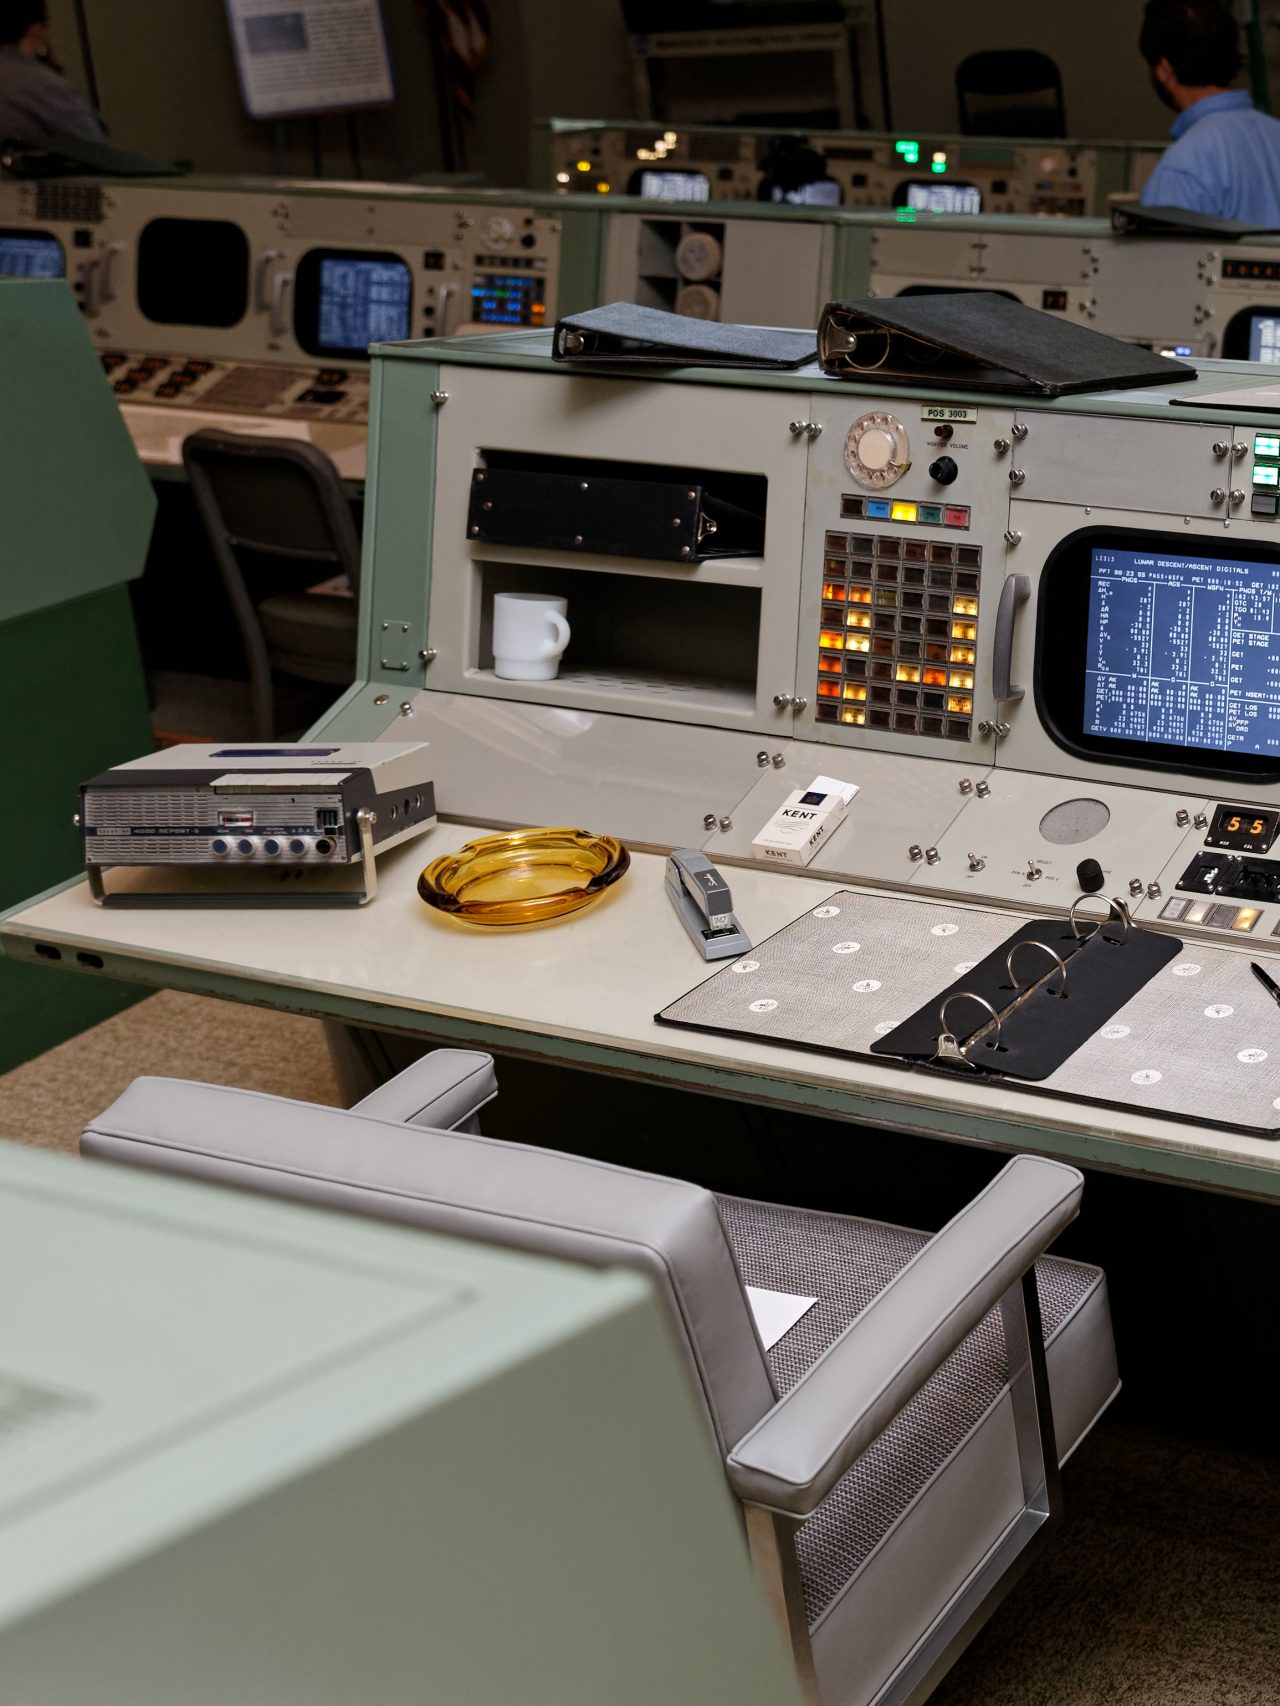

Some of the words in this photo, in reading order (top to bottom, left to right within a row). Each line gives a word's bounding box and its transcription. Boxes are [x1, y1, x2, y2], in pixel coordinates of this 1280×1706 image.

[927, 409, 945, 418] POS
[948, 409, 968, 419] 3003
[949, 442, 969, 450] VOLUME
[1134, 558, 1155, 566] LUNAR
[1157, 560, 1213, 571] DESCENT/ASCENT
[1216, 566, 1249, 574] DIGITALS
[1239, 587, 1256, 595] PNGS
[1248, 633, 1270, 641] STAGE
[1248, 640, 1270, 648] STAGE
[782, 808, 818, 820] KENT
[809, 824, 824, 846] KENT
[764, 849, 788, 858] KENT
